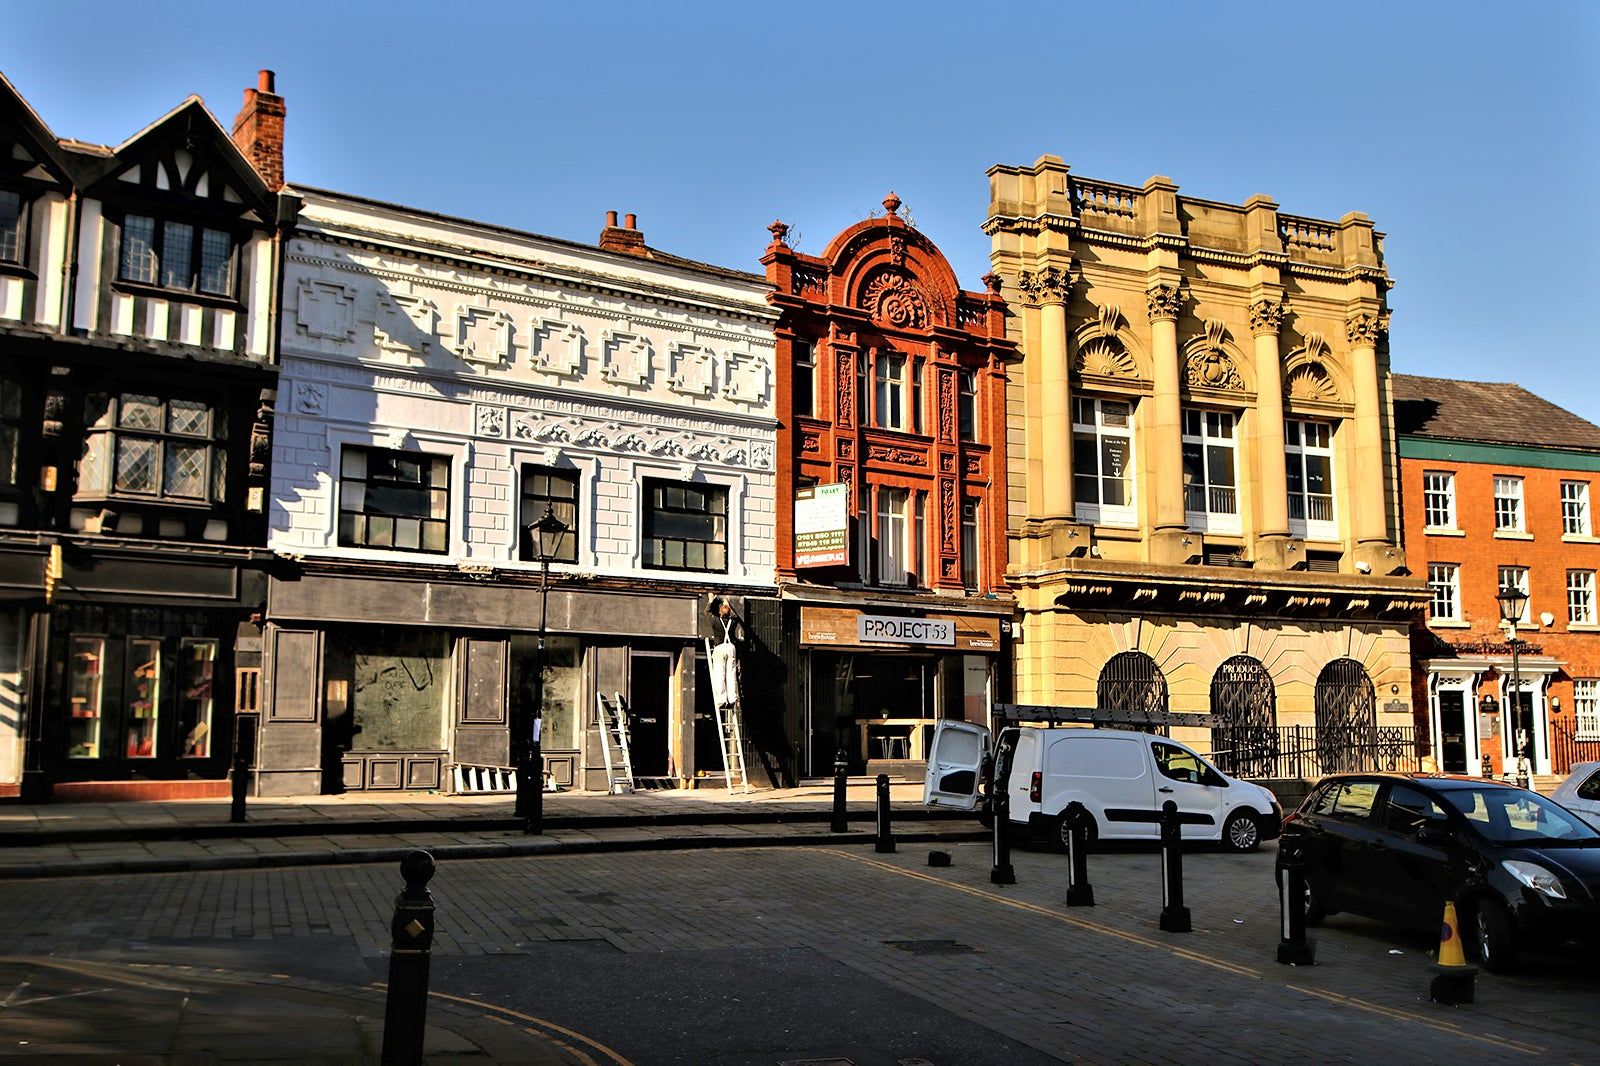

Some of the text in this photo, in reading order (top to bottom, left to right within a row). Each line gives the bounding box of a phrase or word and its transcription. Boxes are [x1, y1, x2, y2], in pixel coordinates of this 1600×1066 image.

[830, 530, 845, 538] 1111
[864, 619, 947, 640] PROJECT 53
[807, 631, 837, 641] brewhouse
[969, 639, 994, 648] brewhouse
[1229, 672, 1255, 682] HALL
